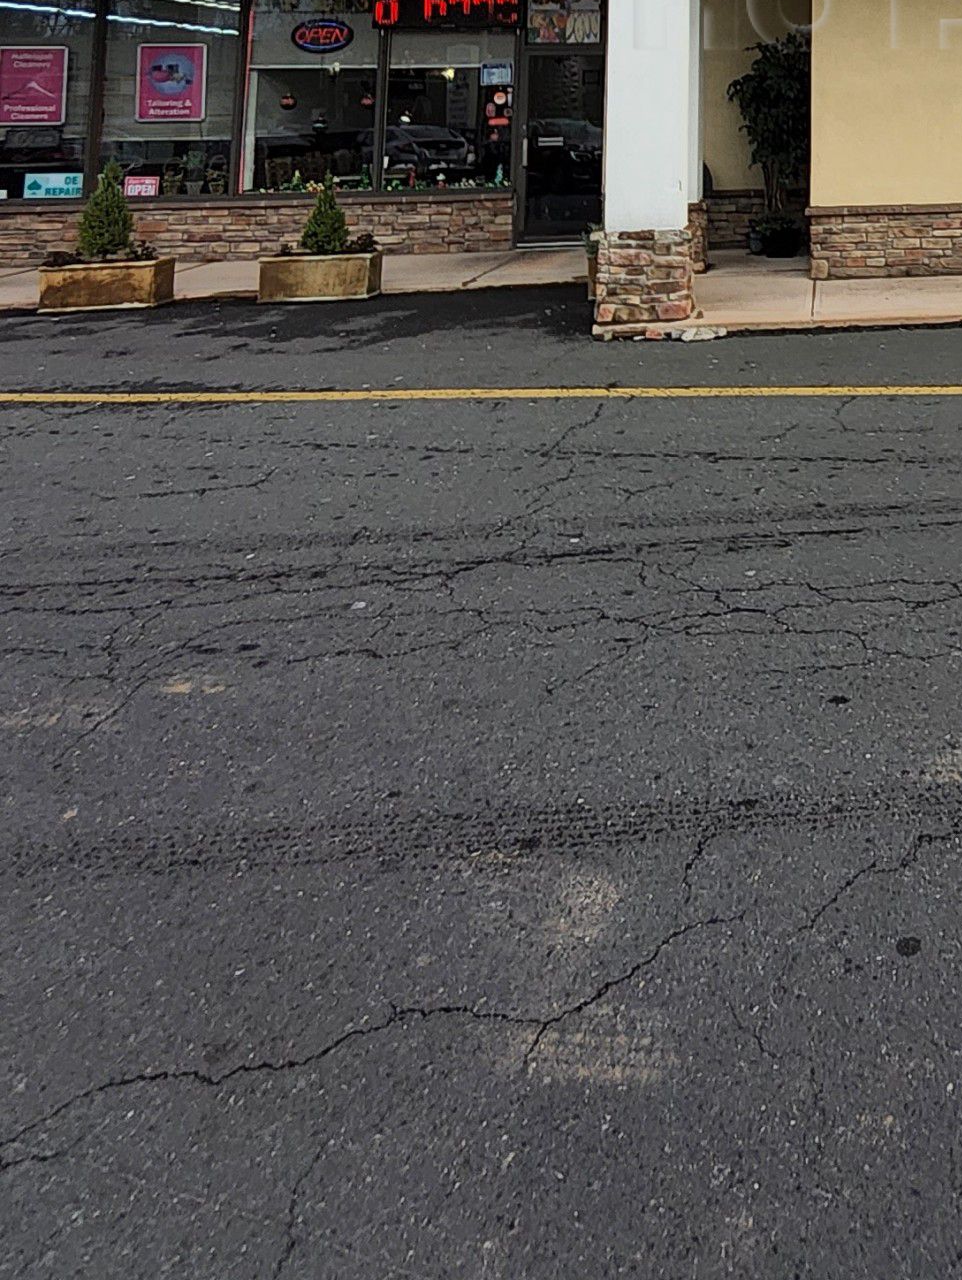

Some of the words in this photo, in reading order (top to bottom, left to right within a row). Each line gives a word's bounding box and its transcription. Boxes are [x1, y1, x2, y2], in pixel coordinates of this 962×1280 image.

[295, 25, 349, 45] OPEN
[3, 104, 57, 112] Professional
[127, 184, 156, 196] OPEN
